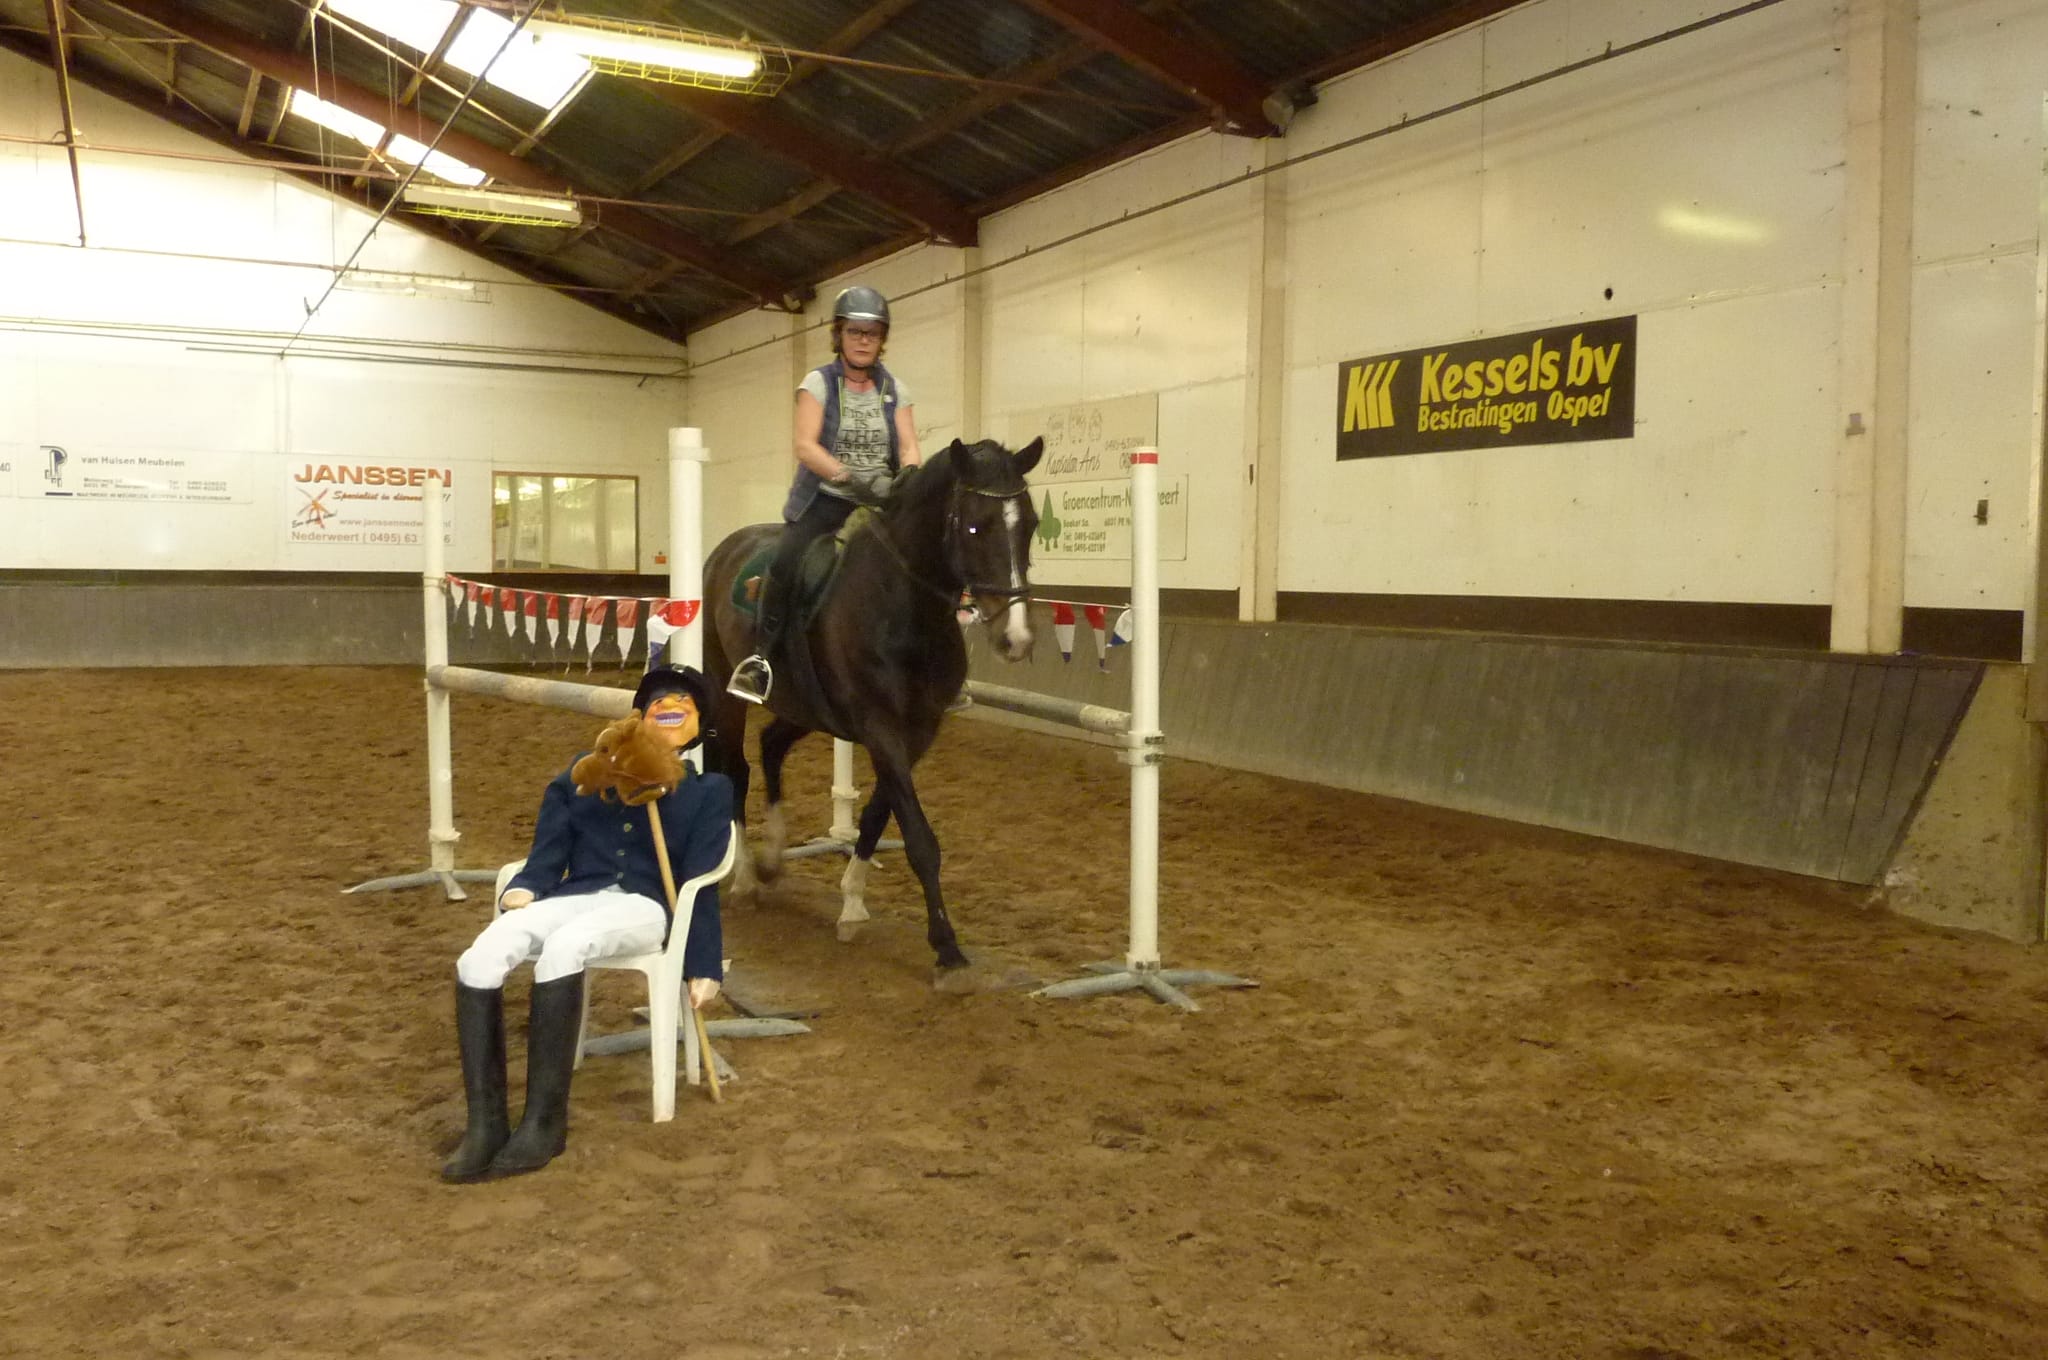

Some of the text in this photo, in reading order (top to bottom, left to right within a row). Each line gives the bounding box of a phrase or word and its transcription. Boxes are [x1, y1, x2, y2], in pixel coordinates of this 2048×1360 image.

[1420, 333, 1621, 404] Kessels bv
[1418, 387, 1611, 434] Bestratingen Ospel
[81, 456, 98, 464] van
[138, 457, 185, 467] Meubelen
[294, 464, 452, 488] JANSSEN
[291, 531, 359, 542] Nederweert
